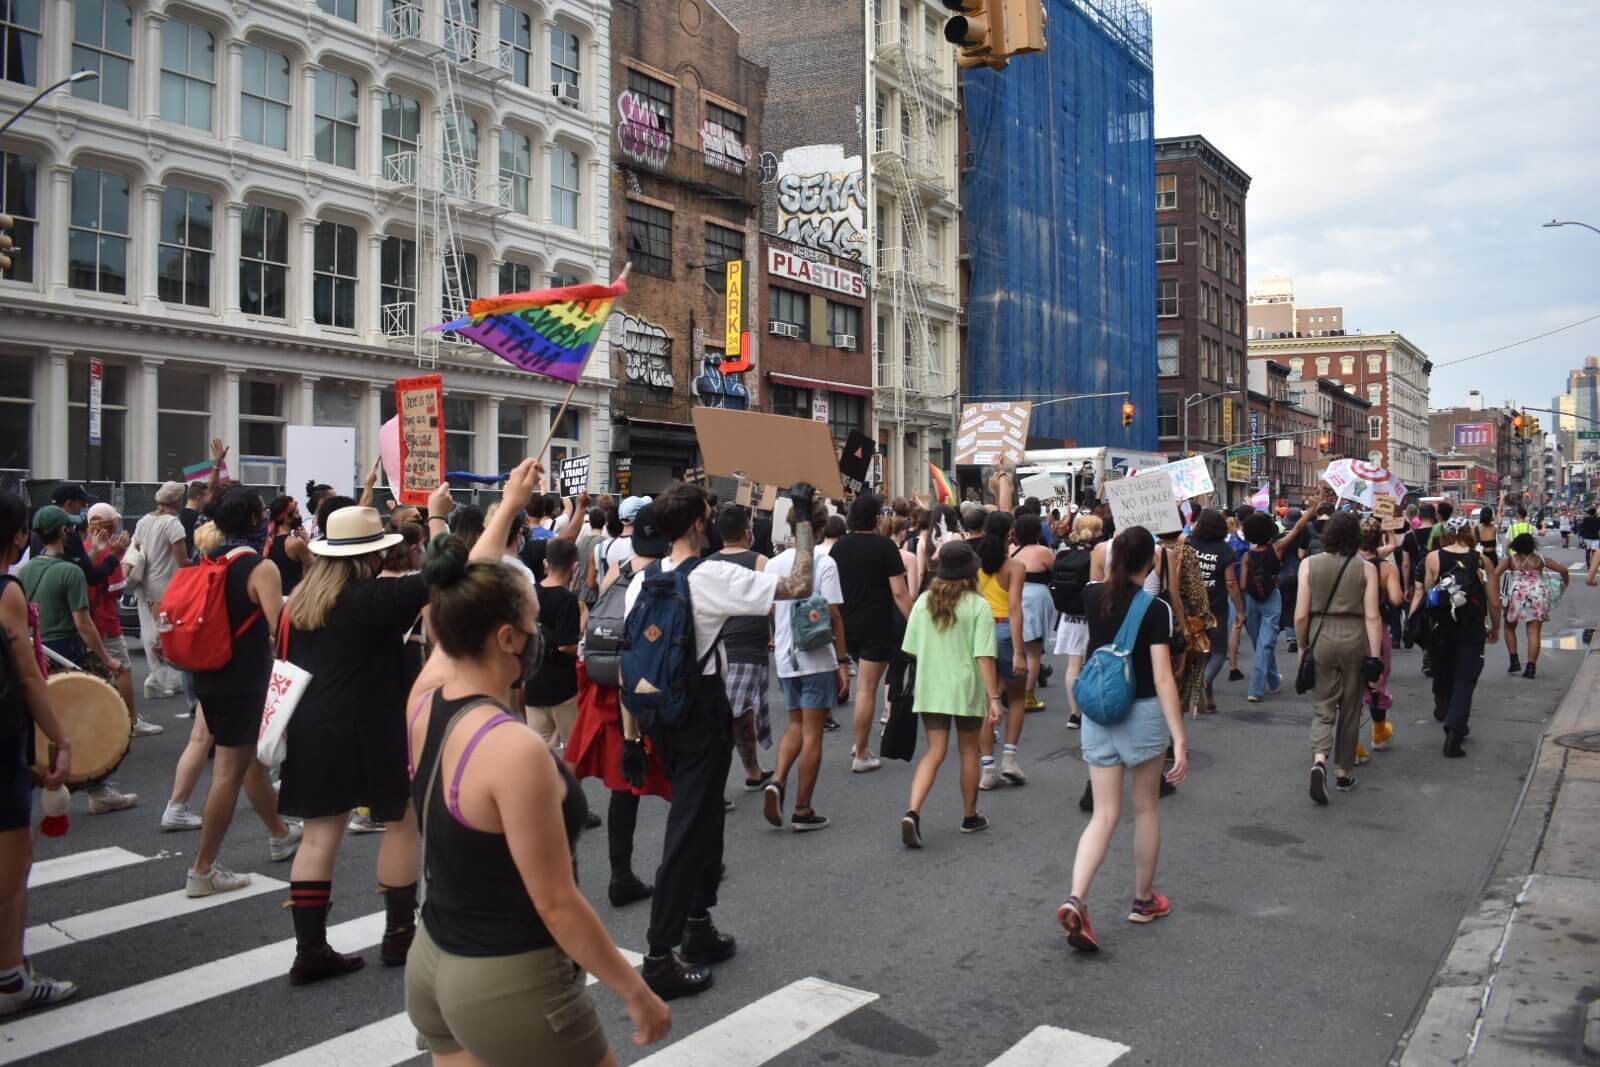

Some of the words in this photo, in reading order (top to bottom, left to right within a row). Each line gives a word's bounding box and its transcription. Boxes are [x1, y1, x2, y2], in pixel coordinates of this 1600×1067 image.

[773, 252, 862, 294] PLASTICS
[728, 263, 740, 334] PARK
[1110, 484, 1126, 497] NO
[1121, 497, 1137, 511] NO
[1195, 550, 1219, 561] LACK
